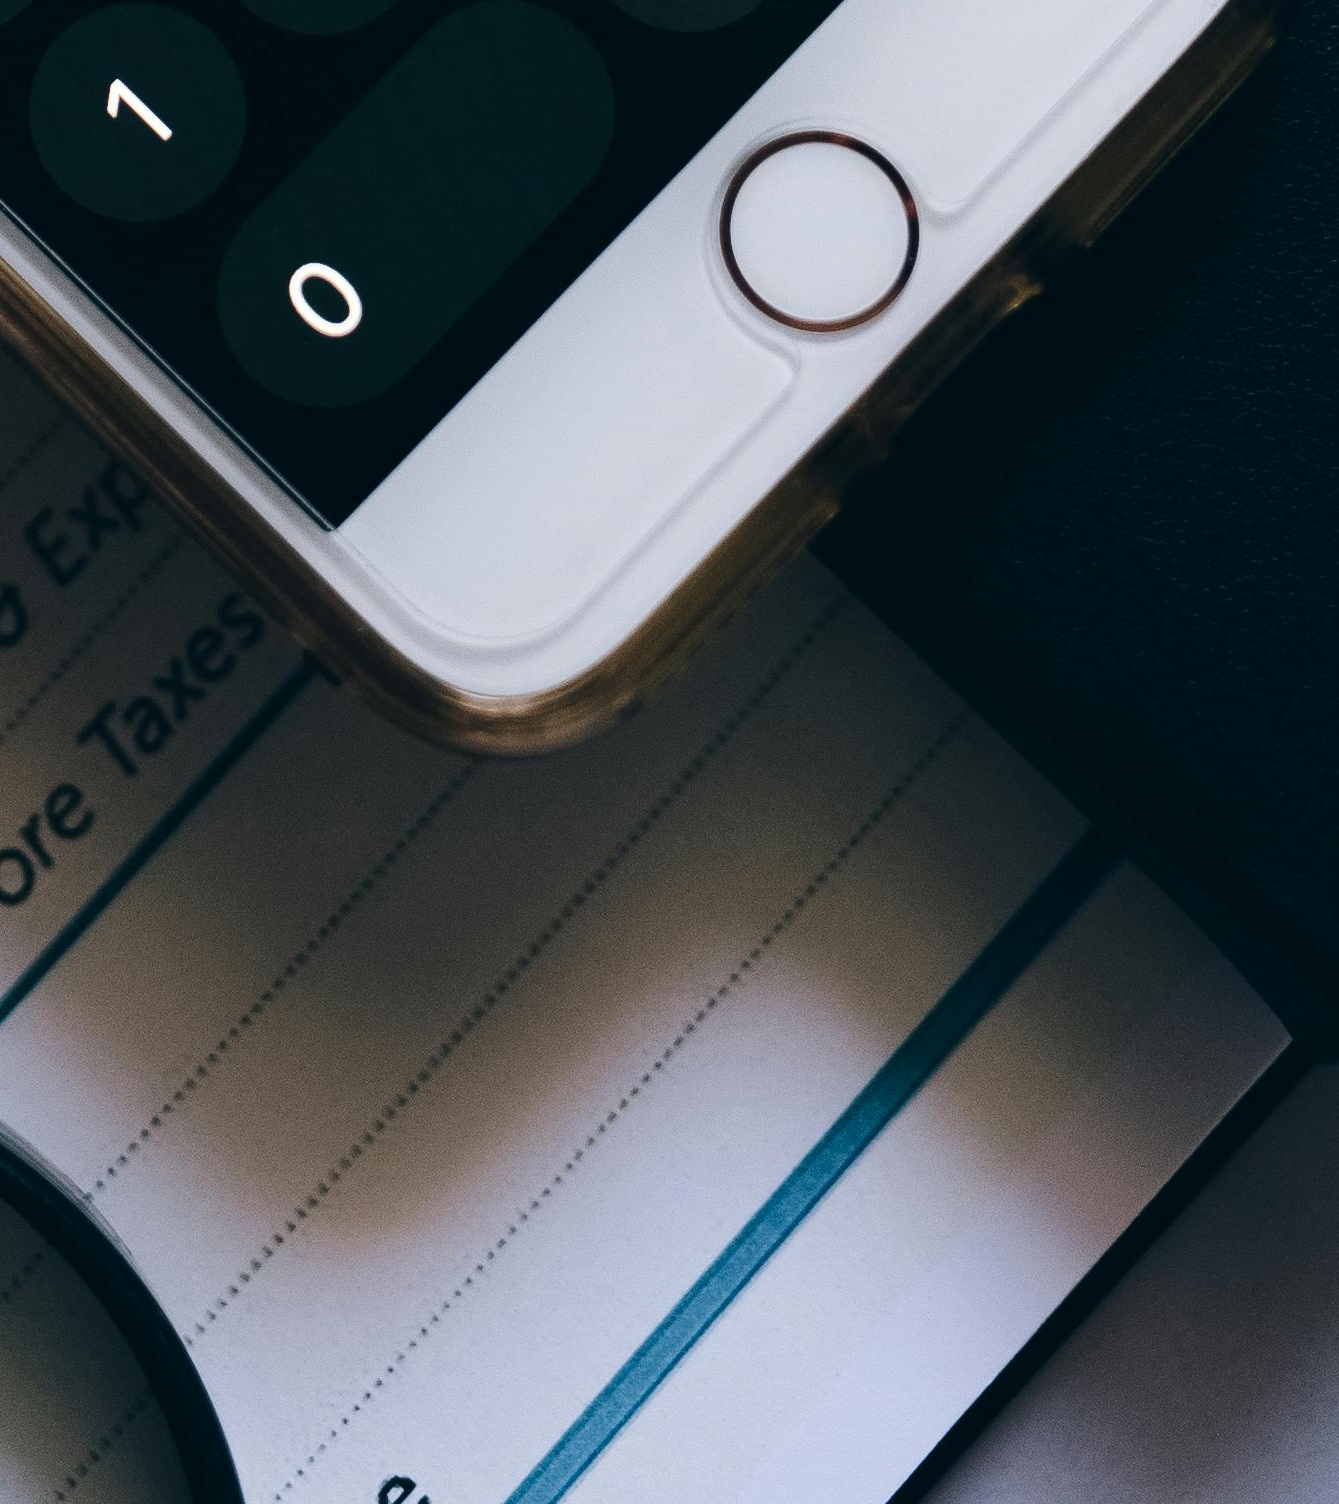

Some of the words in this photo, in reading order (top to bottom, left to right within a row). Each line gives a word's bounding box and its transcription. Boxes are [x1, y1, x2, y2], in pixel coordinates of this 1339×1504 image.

[107, 79, 172, 140] 1
[289, 263, 362, 336] 0
[24, 458, 150, 586] Exp
[77, 591, 266, 777] Taxes
